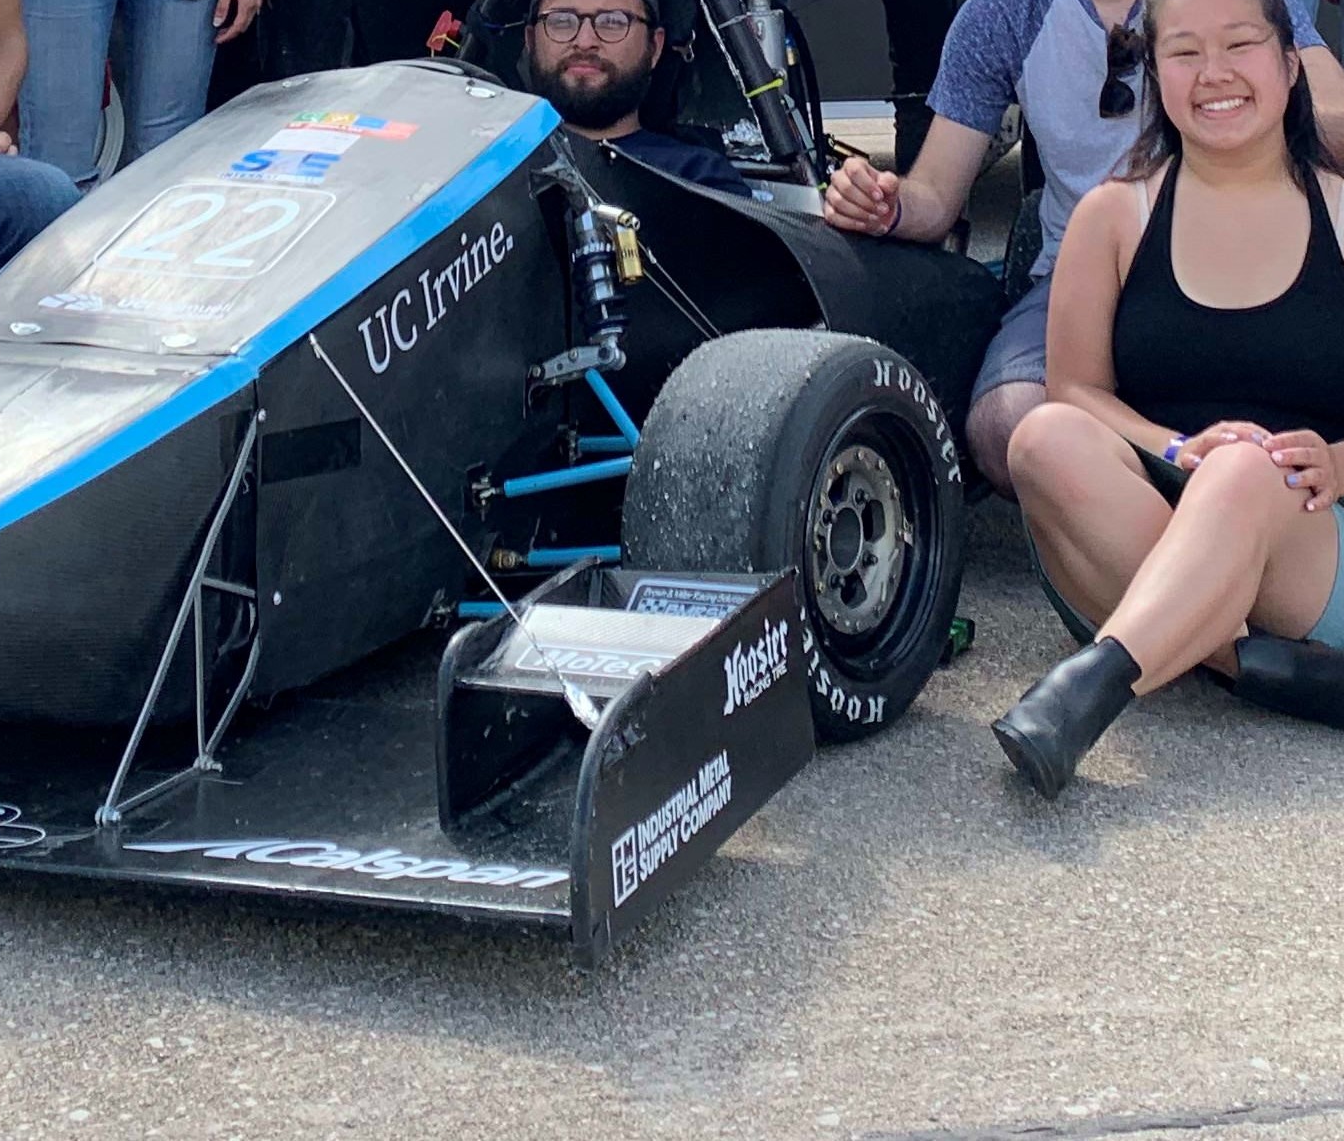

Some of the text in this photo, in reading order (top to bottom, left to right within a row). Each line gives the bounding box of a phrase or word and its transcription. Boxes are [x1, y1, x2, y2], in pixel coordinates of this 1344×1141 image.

[117, 192, 301, 268] 22
[358, 220, 515, 375] UC Irvine.
[723, 617, 789, 717] Hoosier
[744, 663, 788, 707] RACING TIRE
[637, 748, 732, 853] INDUSTRIAL METAL
[638, 775, 733, 882] SUPPLY COMPANY
[245, 840, 571, 889] Calspan
